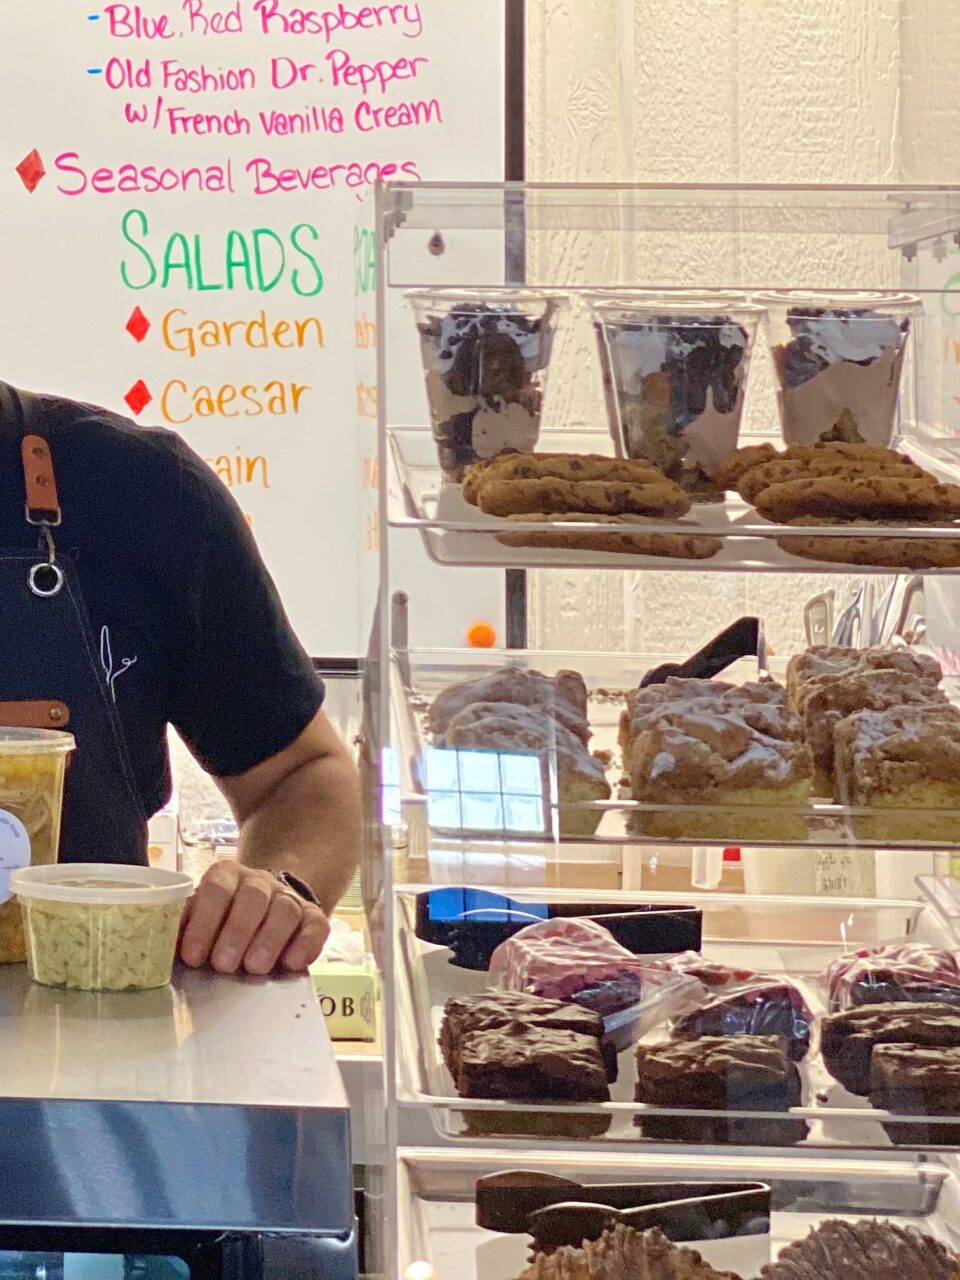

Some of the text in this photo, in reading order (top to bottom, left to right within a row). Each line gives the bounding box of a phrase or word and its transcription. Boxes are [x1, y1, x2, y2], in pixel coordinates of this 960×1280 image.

[161, 59, 256, 93] Fashion
[325, 49, 430, 95] Pepper
[354, 99, 444, 132] Cream
[54, 152, 235, 196] Seasonal
[120, 209, 324, 297] SALADS
[162, 307, 326, 357] Garden
[160, 378, 313, 424] Caesar
[204, 446, 271, 490] ain
